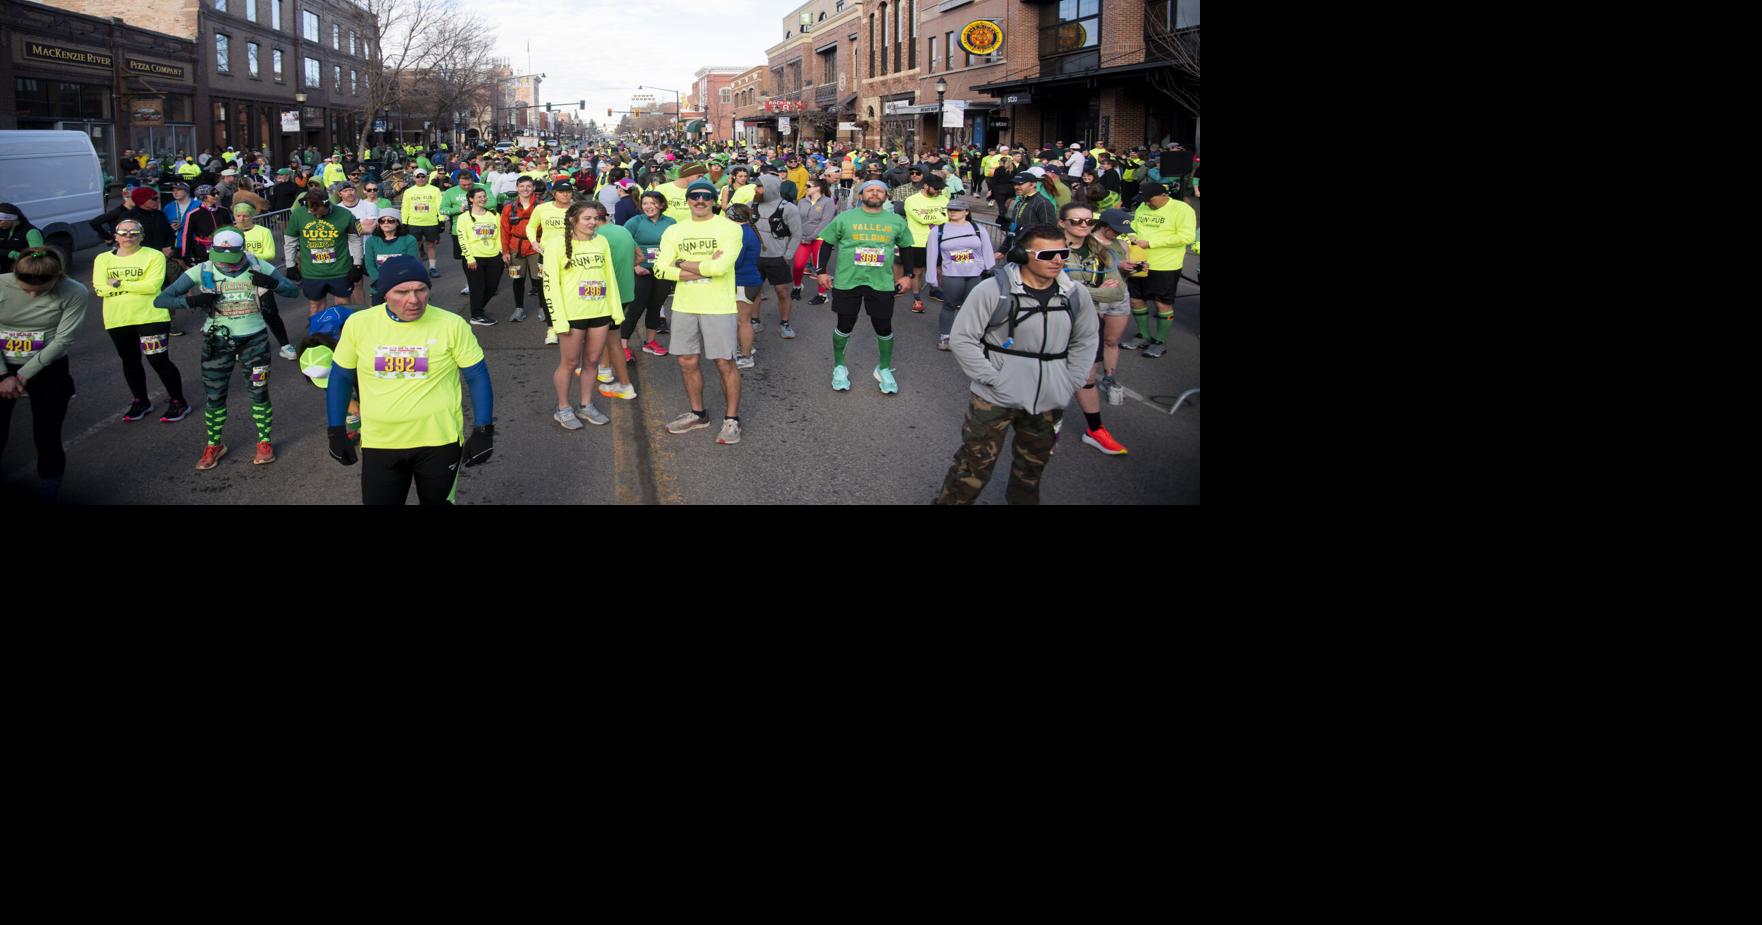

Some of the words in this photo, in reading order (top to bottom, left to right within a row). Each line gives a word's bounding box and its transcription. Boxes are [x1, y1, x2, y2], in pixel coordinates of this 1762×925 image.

[87, 53, 111, 66] RIVER
[130, 60, 150, 71] PIZZA
[151, 63, 182, 76] COMPANY
[303, 230, 339, 238] LUCK
[124, 268, 144, 278] PUB
[5, 338, 32, 352] 420
[384, 355, 415, 373] 392
